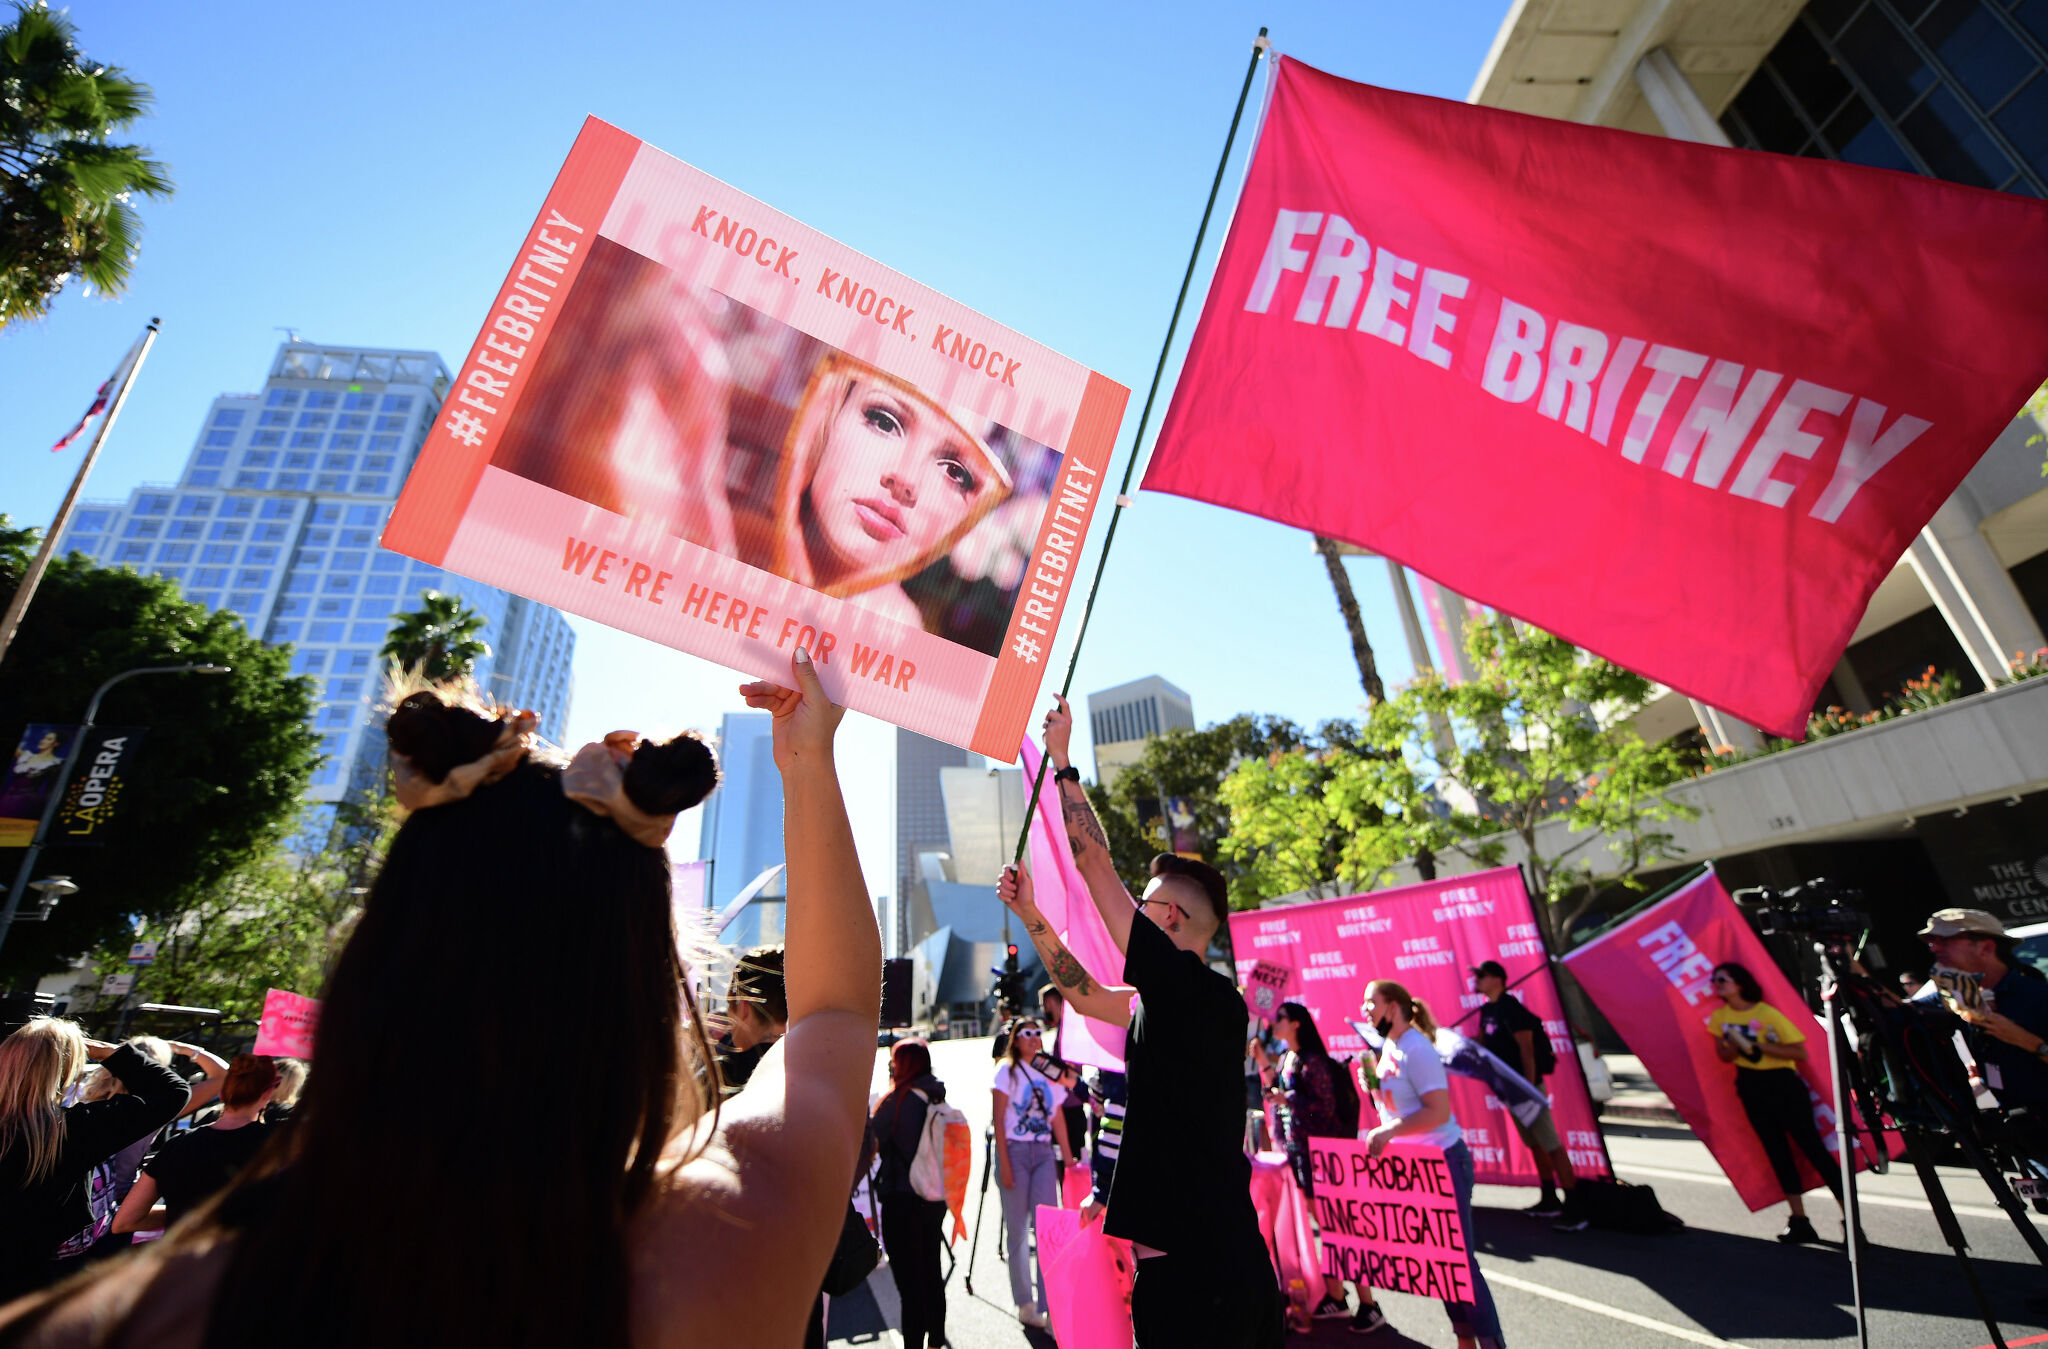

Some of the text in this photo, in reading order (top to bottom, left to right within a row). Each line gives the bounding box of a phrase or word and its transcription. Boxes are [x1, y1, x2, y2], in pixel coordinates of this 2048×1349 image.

[691, 205, 1023, 387] KNOCK, KNOCK, KNOCK
[445, 208, 584, 447] #FREEBRITNEY
[1244, 208, 1934, 524] FREE BRITNEY
[1012, 456, 1097, 664] #FREEBRITNEY
[561, 536, 917, 692] WE'RE HERE FOR WAR
[1989, 861, 2031, 880] THE
[1440, 887, 1479, 905] FREE
[1972, 879, 2040, 901] MUSIC
[1343, 906, 1377, 922] FREE
[1433, 901, 1495, 923] BRITNEY
[1259, 919, 1288, 933] FREE
[1336, 918, 1392, 938] BRITNEY
[1253, 930, 1302, 948] BRITNEY
[1402, 936, 1440, 953] FREE
[1309, 951, 1344, 966] FREE
[1395, 950, 1454, 971] BRITNEY
[1637, 920, 1715, 1007] FREE
[1251, 968, 1287, 989] NEXT
[1302, 964, 1357, 981] BRITNEY
[1311, 1150, 1454, 1198] END PROBATE
[1316, 1195, 1464, 1252] INVESTIGATE
[1322, 1242, 1476, 1306] INCARCERATE
